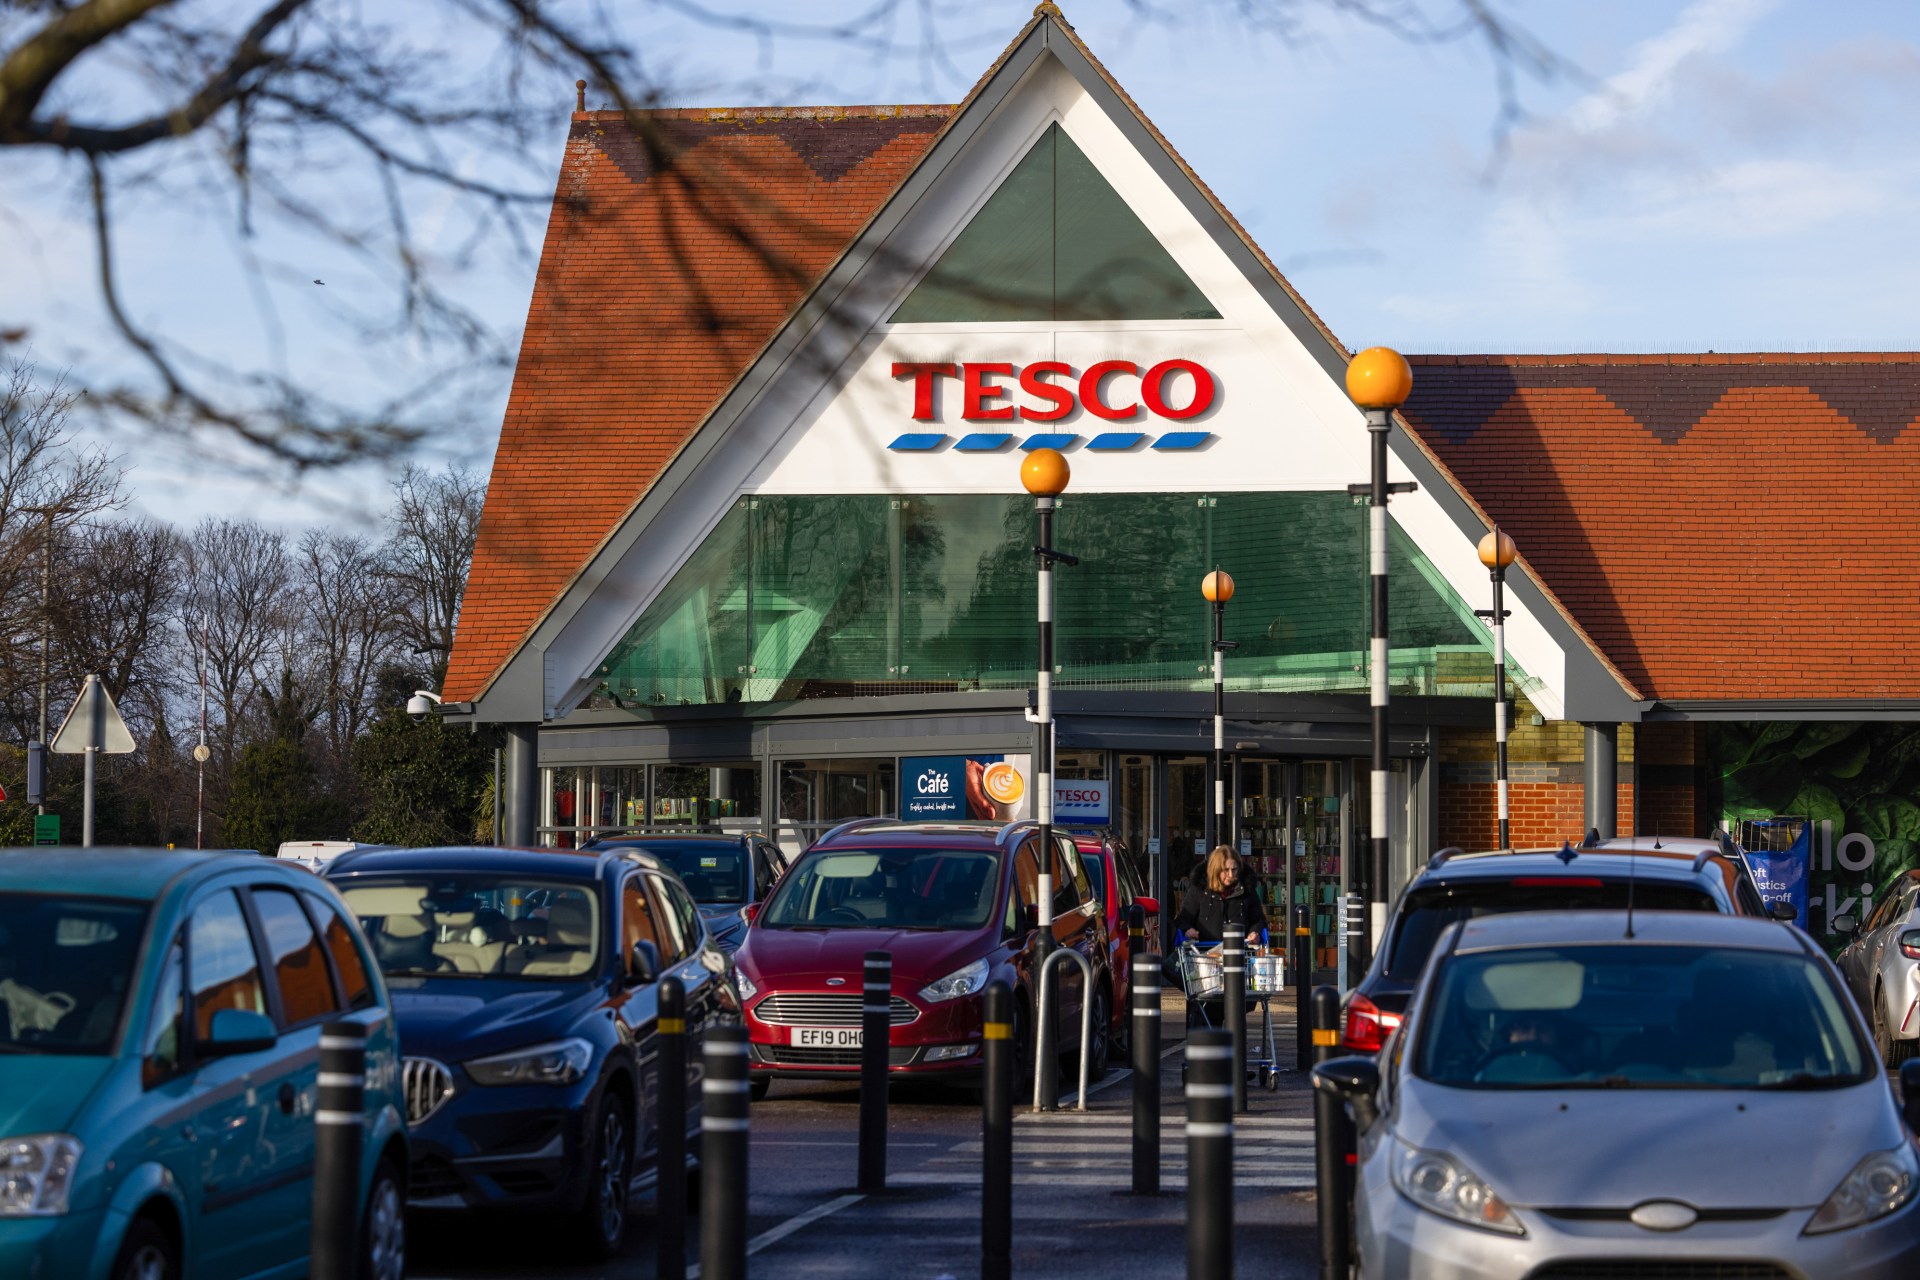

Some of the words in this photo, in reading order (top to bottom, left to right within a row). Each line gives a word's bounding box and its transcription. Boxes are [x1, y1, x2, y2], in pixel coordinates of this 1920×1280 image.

[891, 359, 1215, 421] TESCO
[917, 773, 949, 794] Café
[1055, 789, 1102, 802] TESCO
[1752, 867, 1767, 878] oft
[1762, 892, 1792, 902] p-off
[801, 1030, 834, 1045] EF19
